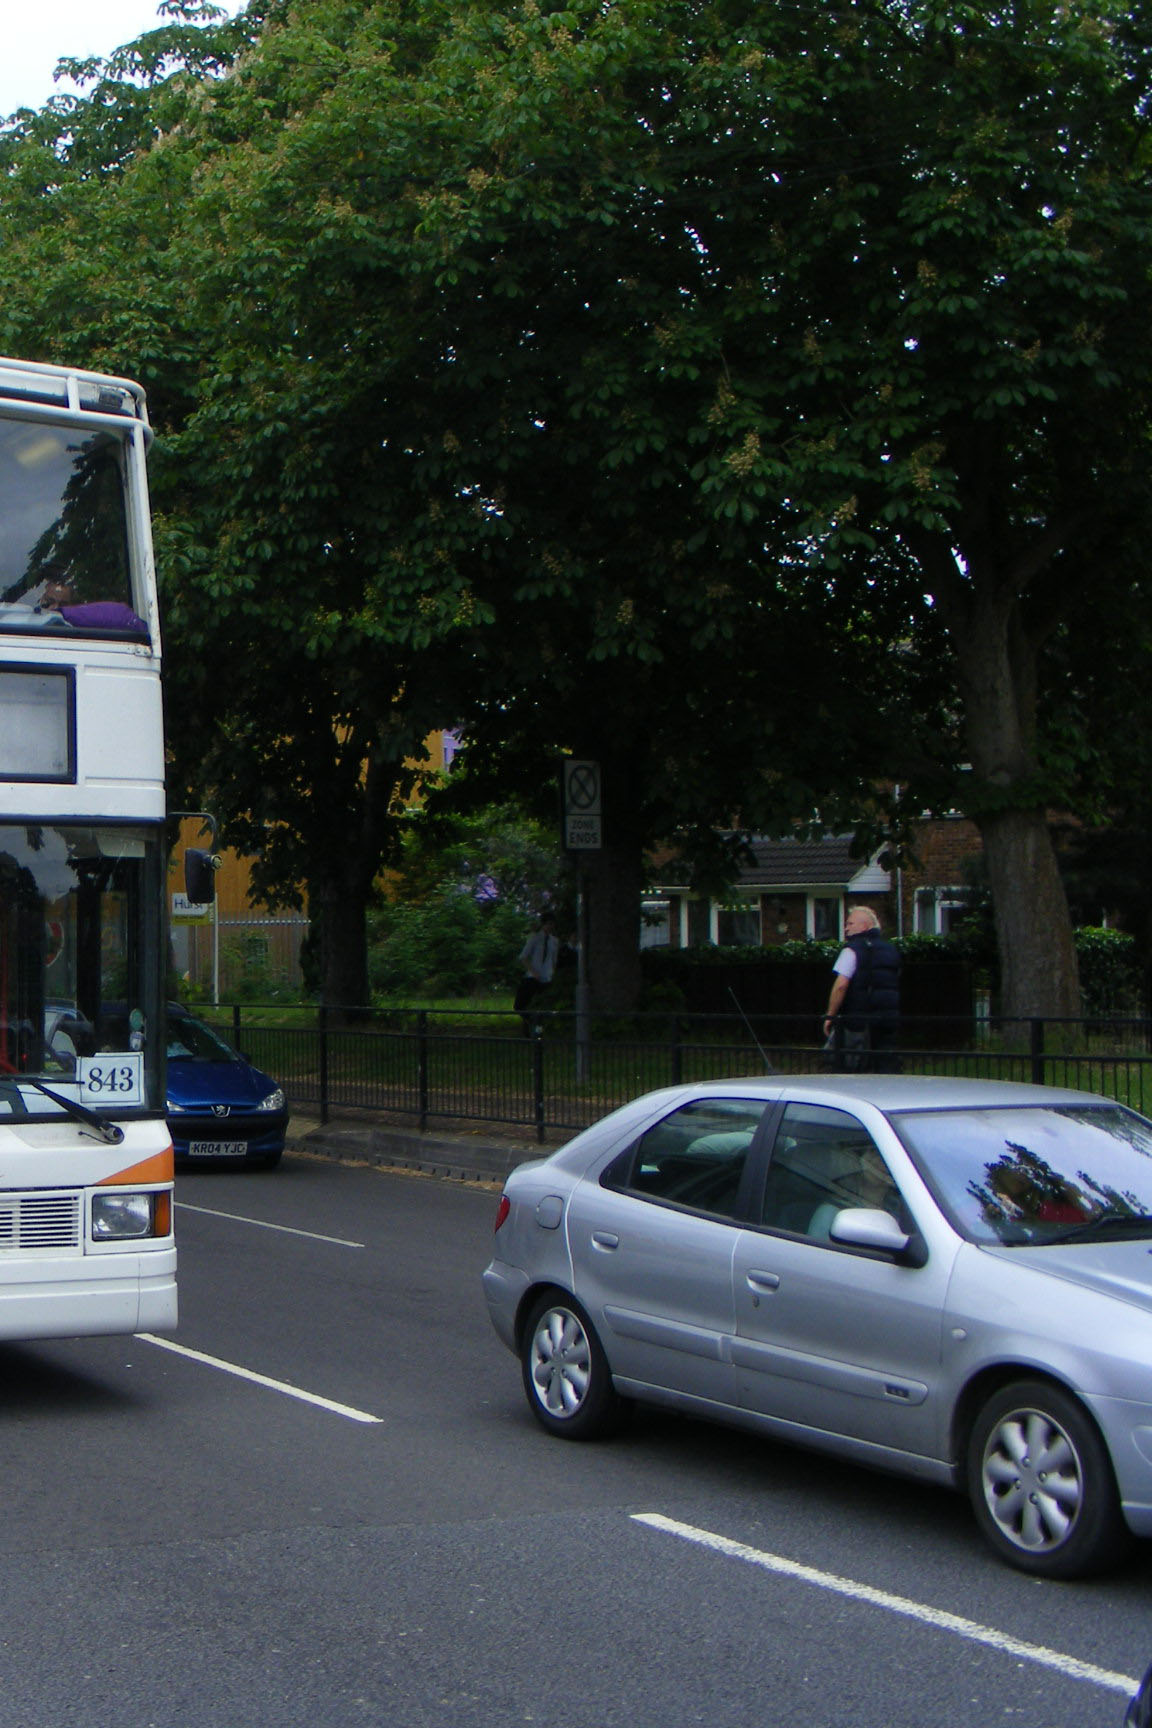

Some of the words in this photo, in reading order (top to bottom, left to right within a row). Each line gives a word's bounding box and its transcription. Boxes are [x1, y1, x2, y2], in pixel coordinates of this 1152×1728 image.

[569, 832, 599, 844] ENDS
[88, 1066, 134, 1093] 843
[193, 1143, 221, 1154] KR04
